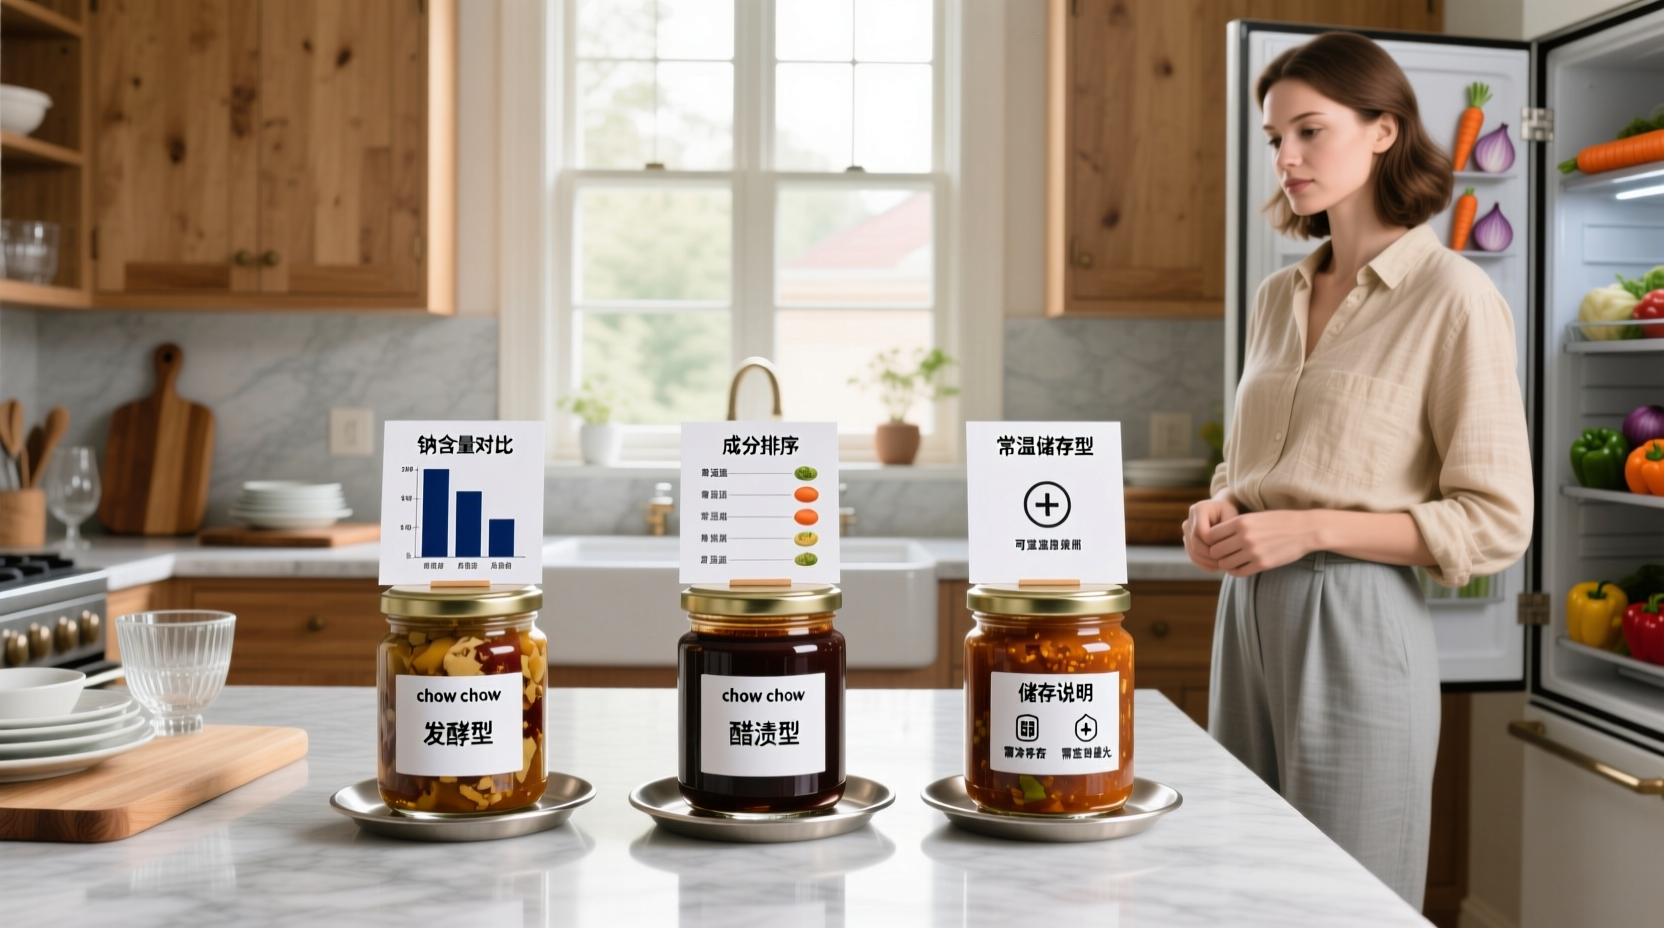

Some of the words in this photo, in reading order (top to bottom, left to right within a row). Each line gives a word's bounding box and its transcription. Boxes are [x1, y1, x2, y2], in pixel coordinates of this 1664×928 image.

[417, 433, 514, 456] 钠含量对比
[722, 434, 799, 457] 成分排序
[996, 434, 1094, 457] 常温储存型
[416, 687, 457, 703] chow
[460, 687, 502, 702] chow
[722, 687, 763, 703] chow
[766, 687, 806, 702] chow
[1018, 681, 1093, 703] 储存说明
[423, 720, 494, 747] 发酵型
[729, 719, 800, 747] 醋渍型
